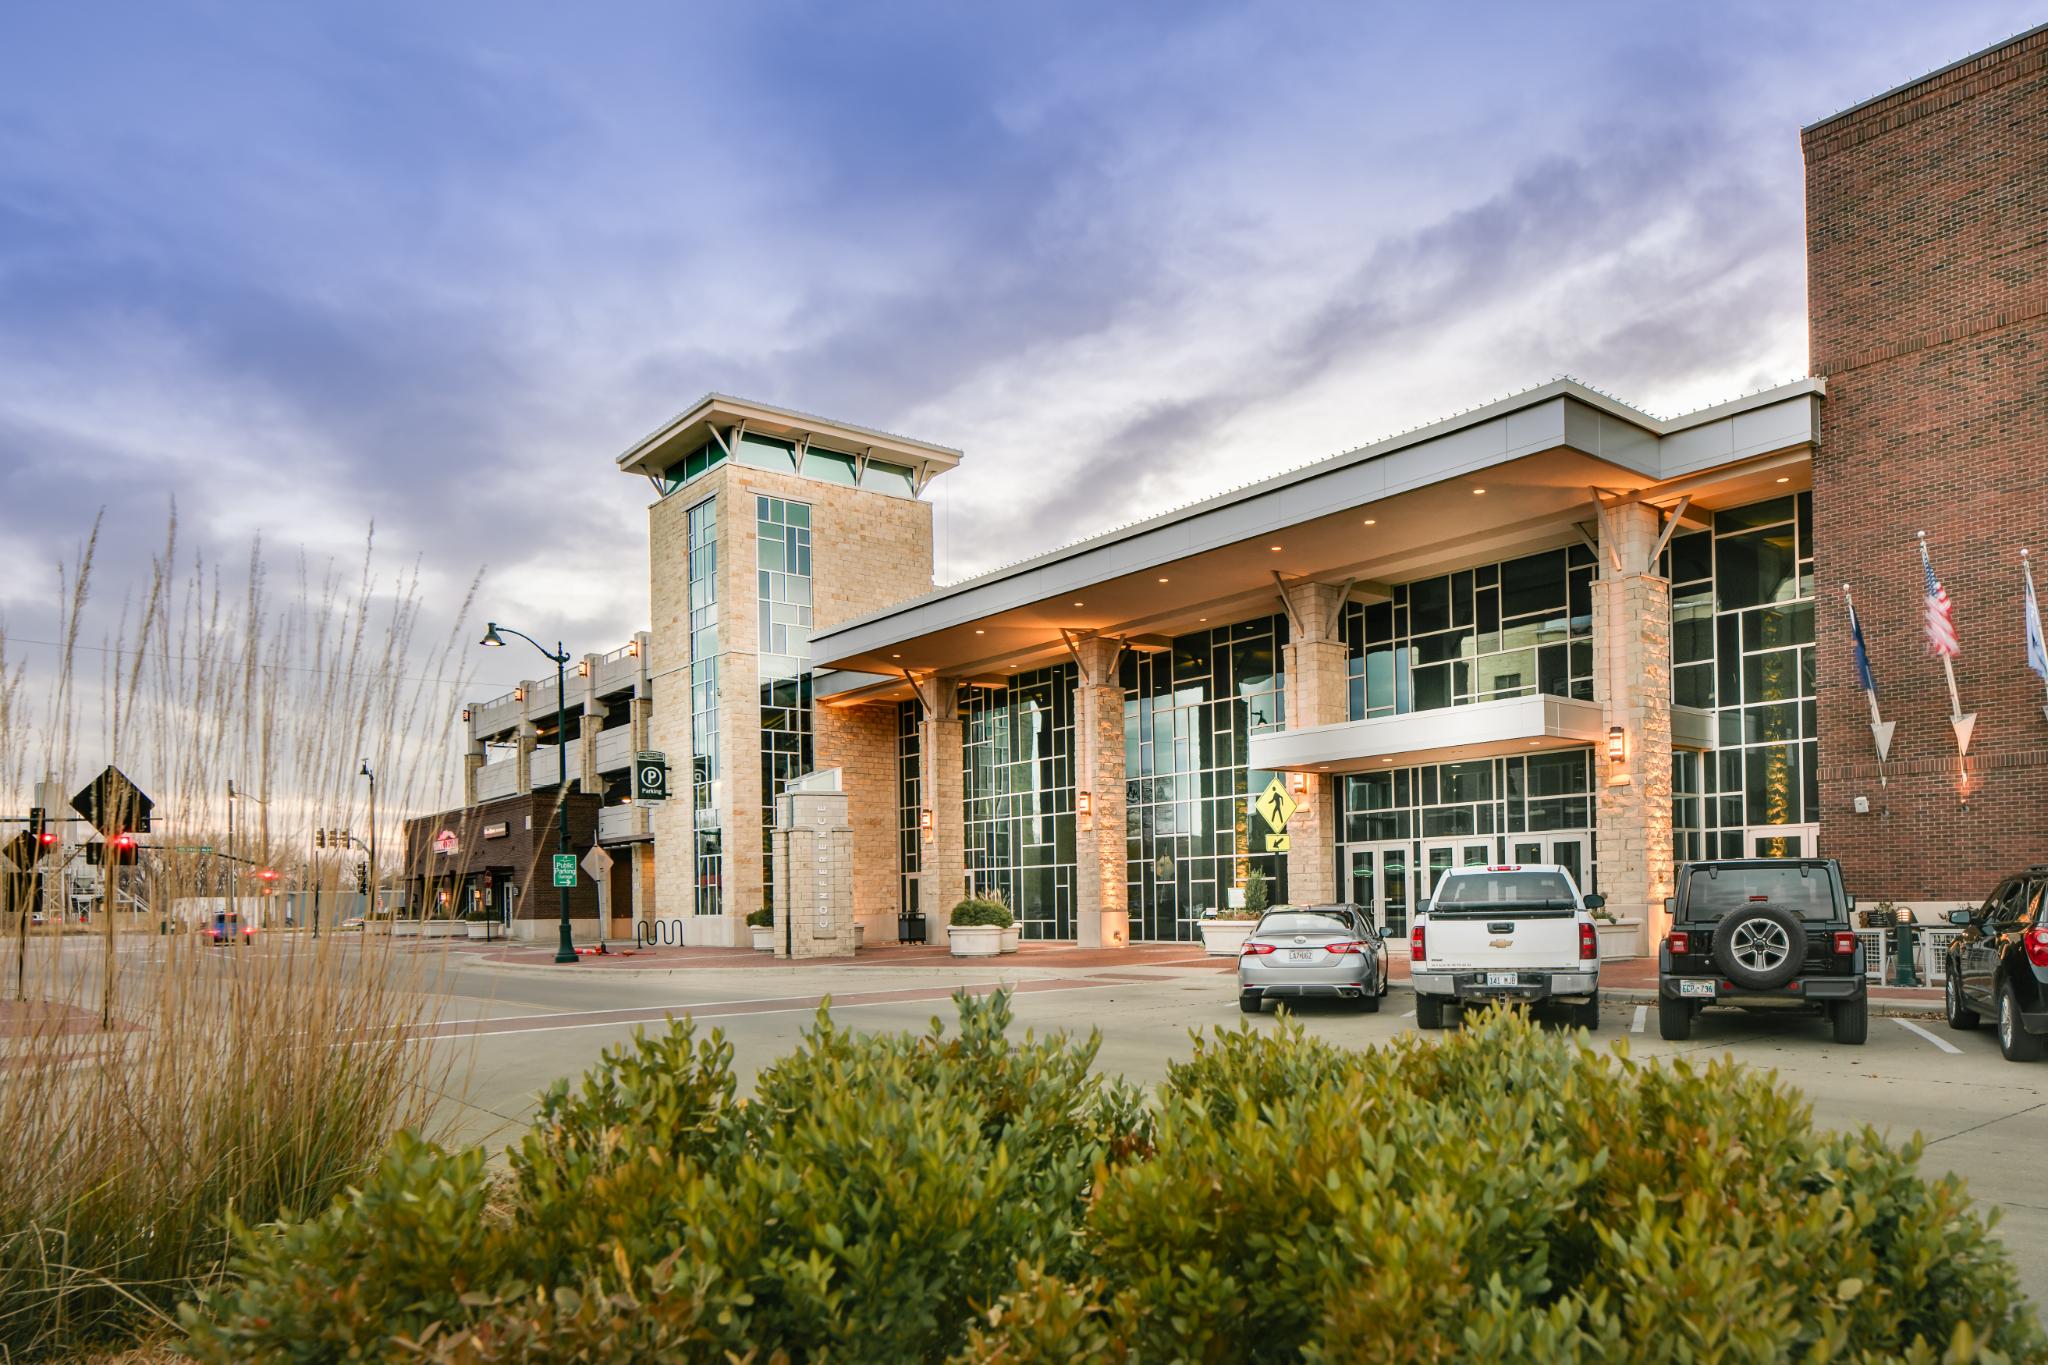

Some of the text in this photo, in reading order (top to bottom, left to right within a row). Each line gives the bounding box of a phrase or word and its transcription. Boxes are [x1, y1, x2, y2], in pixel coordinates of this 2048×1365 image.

[647, 770, 657, 784] P
[554, 867, 576, 875] Parking
[817, 803, 828, 928] CONFERENCE
